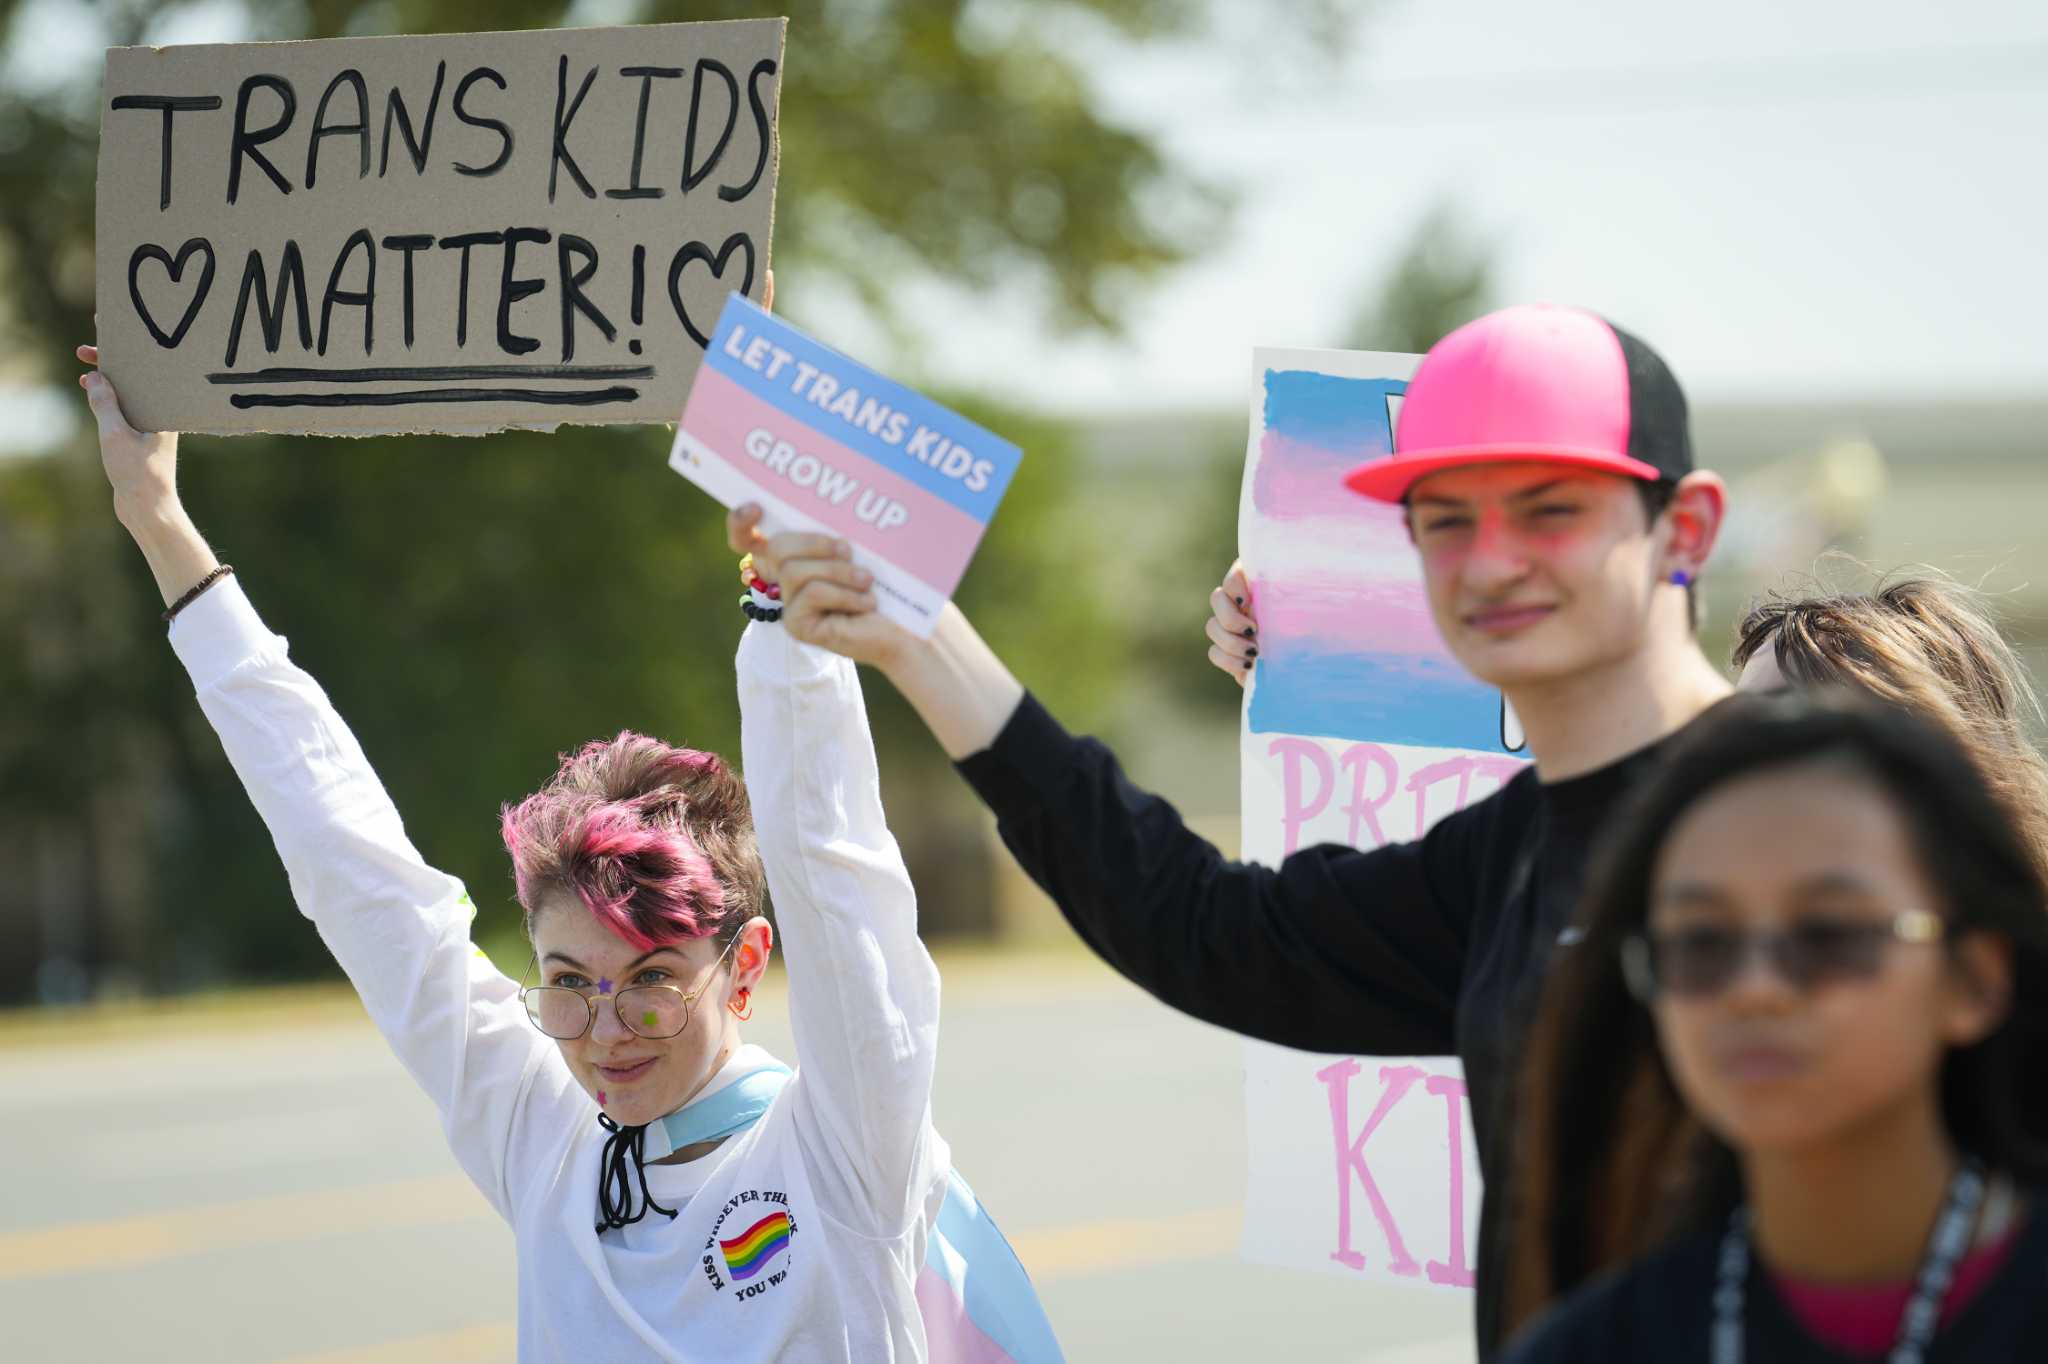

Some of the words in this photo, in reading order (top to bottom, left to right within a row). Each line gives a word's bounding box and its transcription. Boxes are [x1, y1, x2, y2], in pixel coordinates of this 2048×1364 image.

[111, 60, 515, 212] TRANS
[548, 55, 777, 204] KIDS
[224, 227, 646, 367] MATTER!
[724, 325, 792, 381] LET
[790, 362, 910, 446] TRANS
[905, 426, 995, 493] KIDS
[744, 427, 860, 506] GROW
[855, 489, 909, 530] UP
[1315, 1057, 1476, 1288] KI
[703, 1254, 726, 1291] KISS
[735, 1281, 767, 1302] YOU
